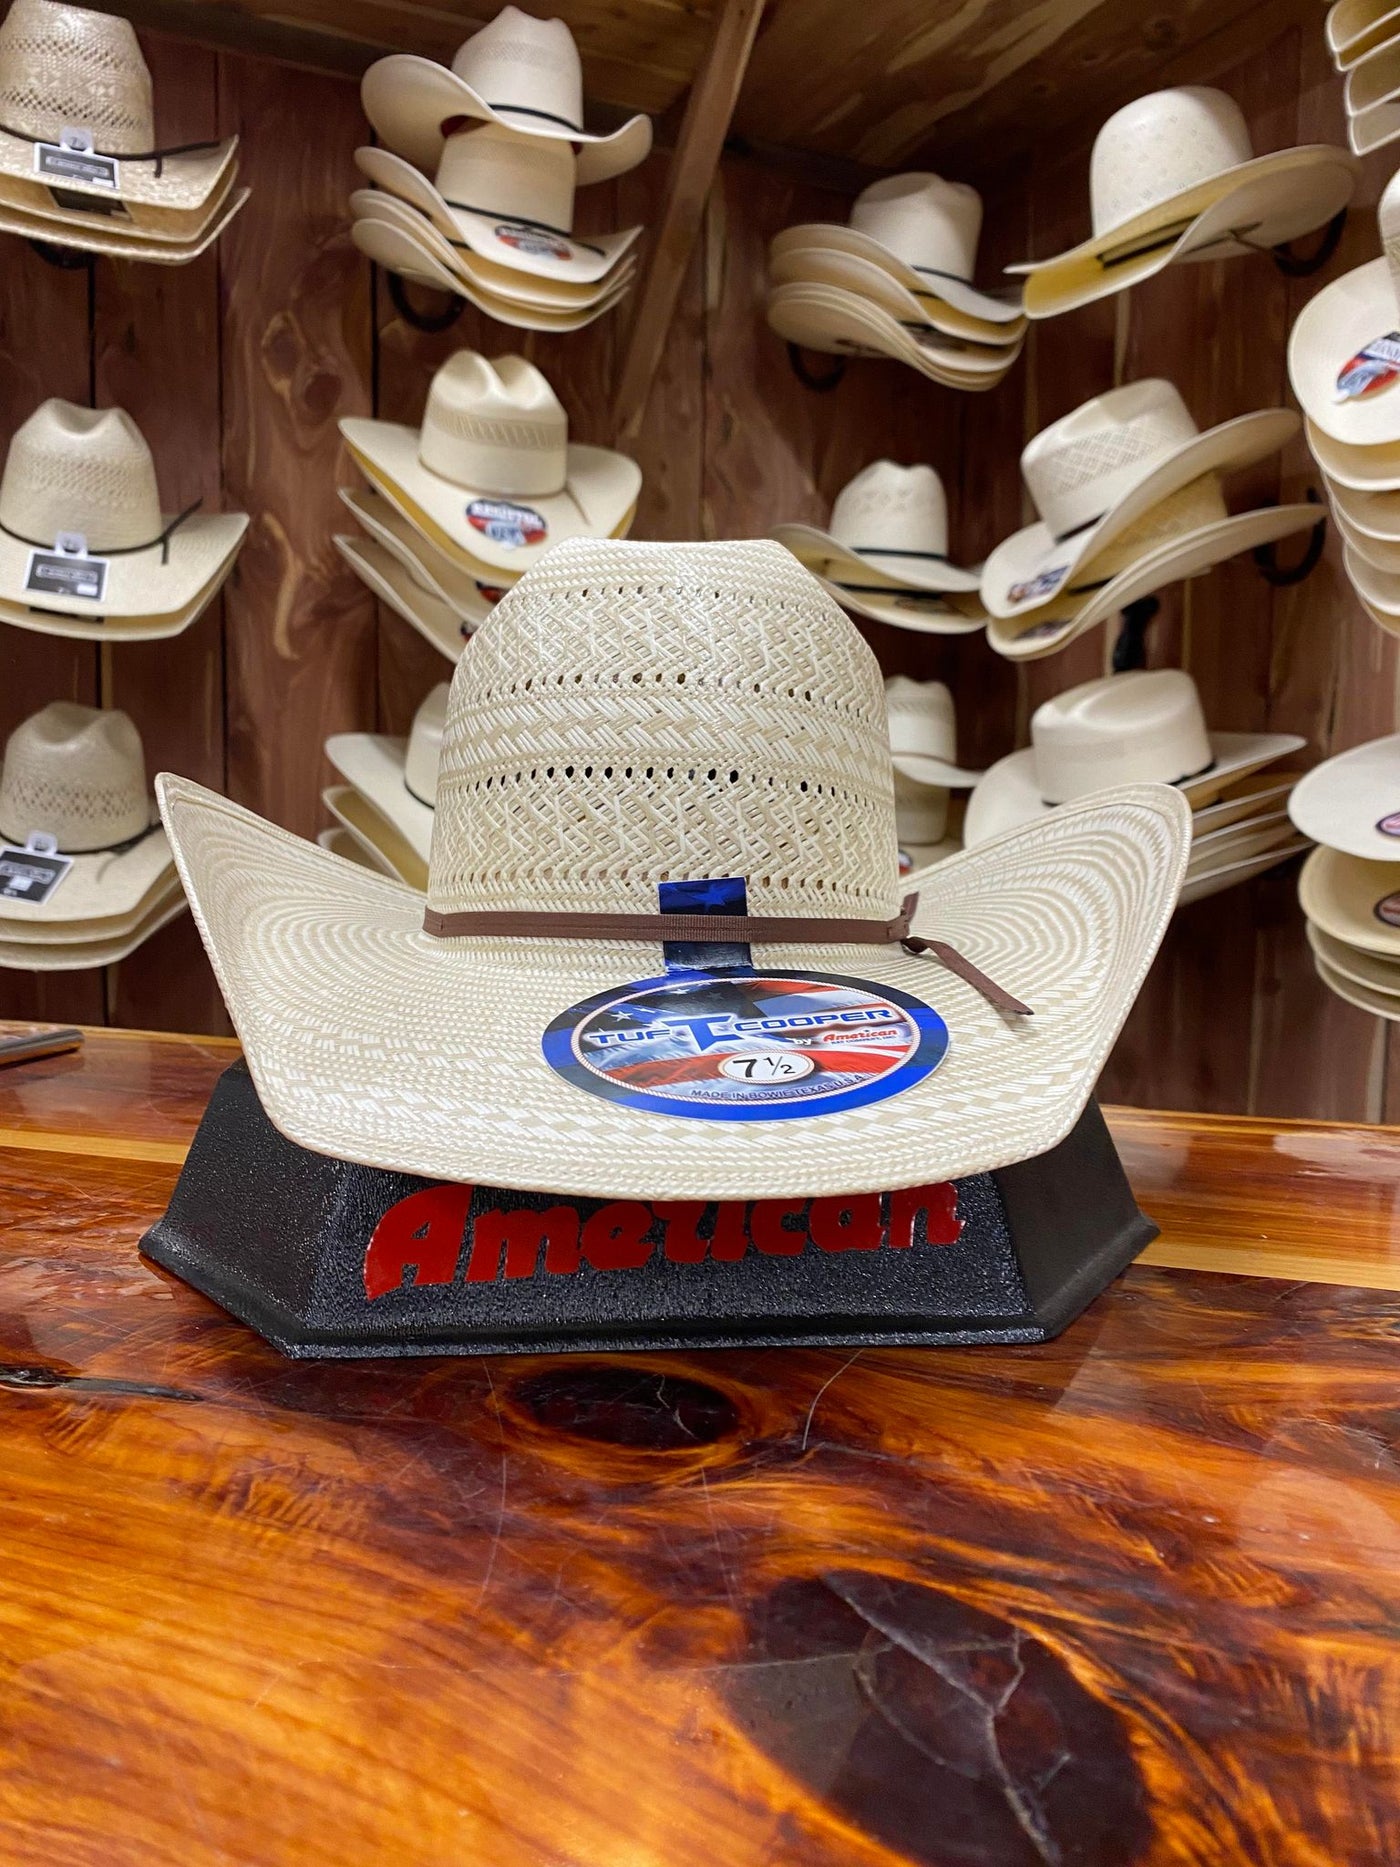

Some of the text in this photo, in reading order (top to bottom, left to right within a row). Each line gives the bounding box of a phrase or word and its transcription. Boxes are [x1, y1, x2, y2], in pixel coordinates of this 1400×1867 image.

[589, 1029, 670, 1044] TUF
[735, 1009, 893, 1031] COOPER
[791, 1029, 898, 1046] by American
[732, 1058, 758, 1078] 7
[691, 1089, 728, 1099] MADE
[732, 1091, 745, 1099] IN
[363, 1182, 967, 1300] American
